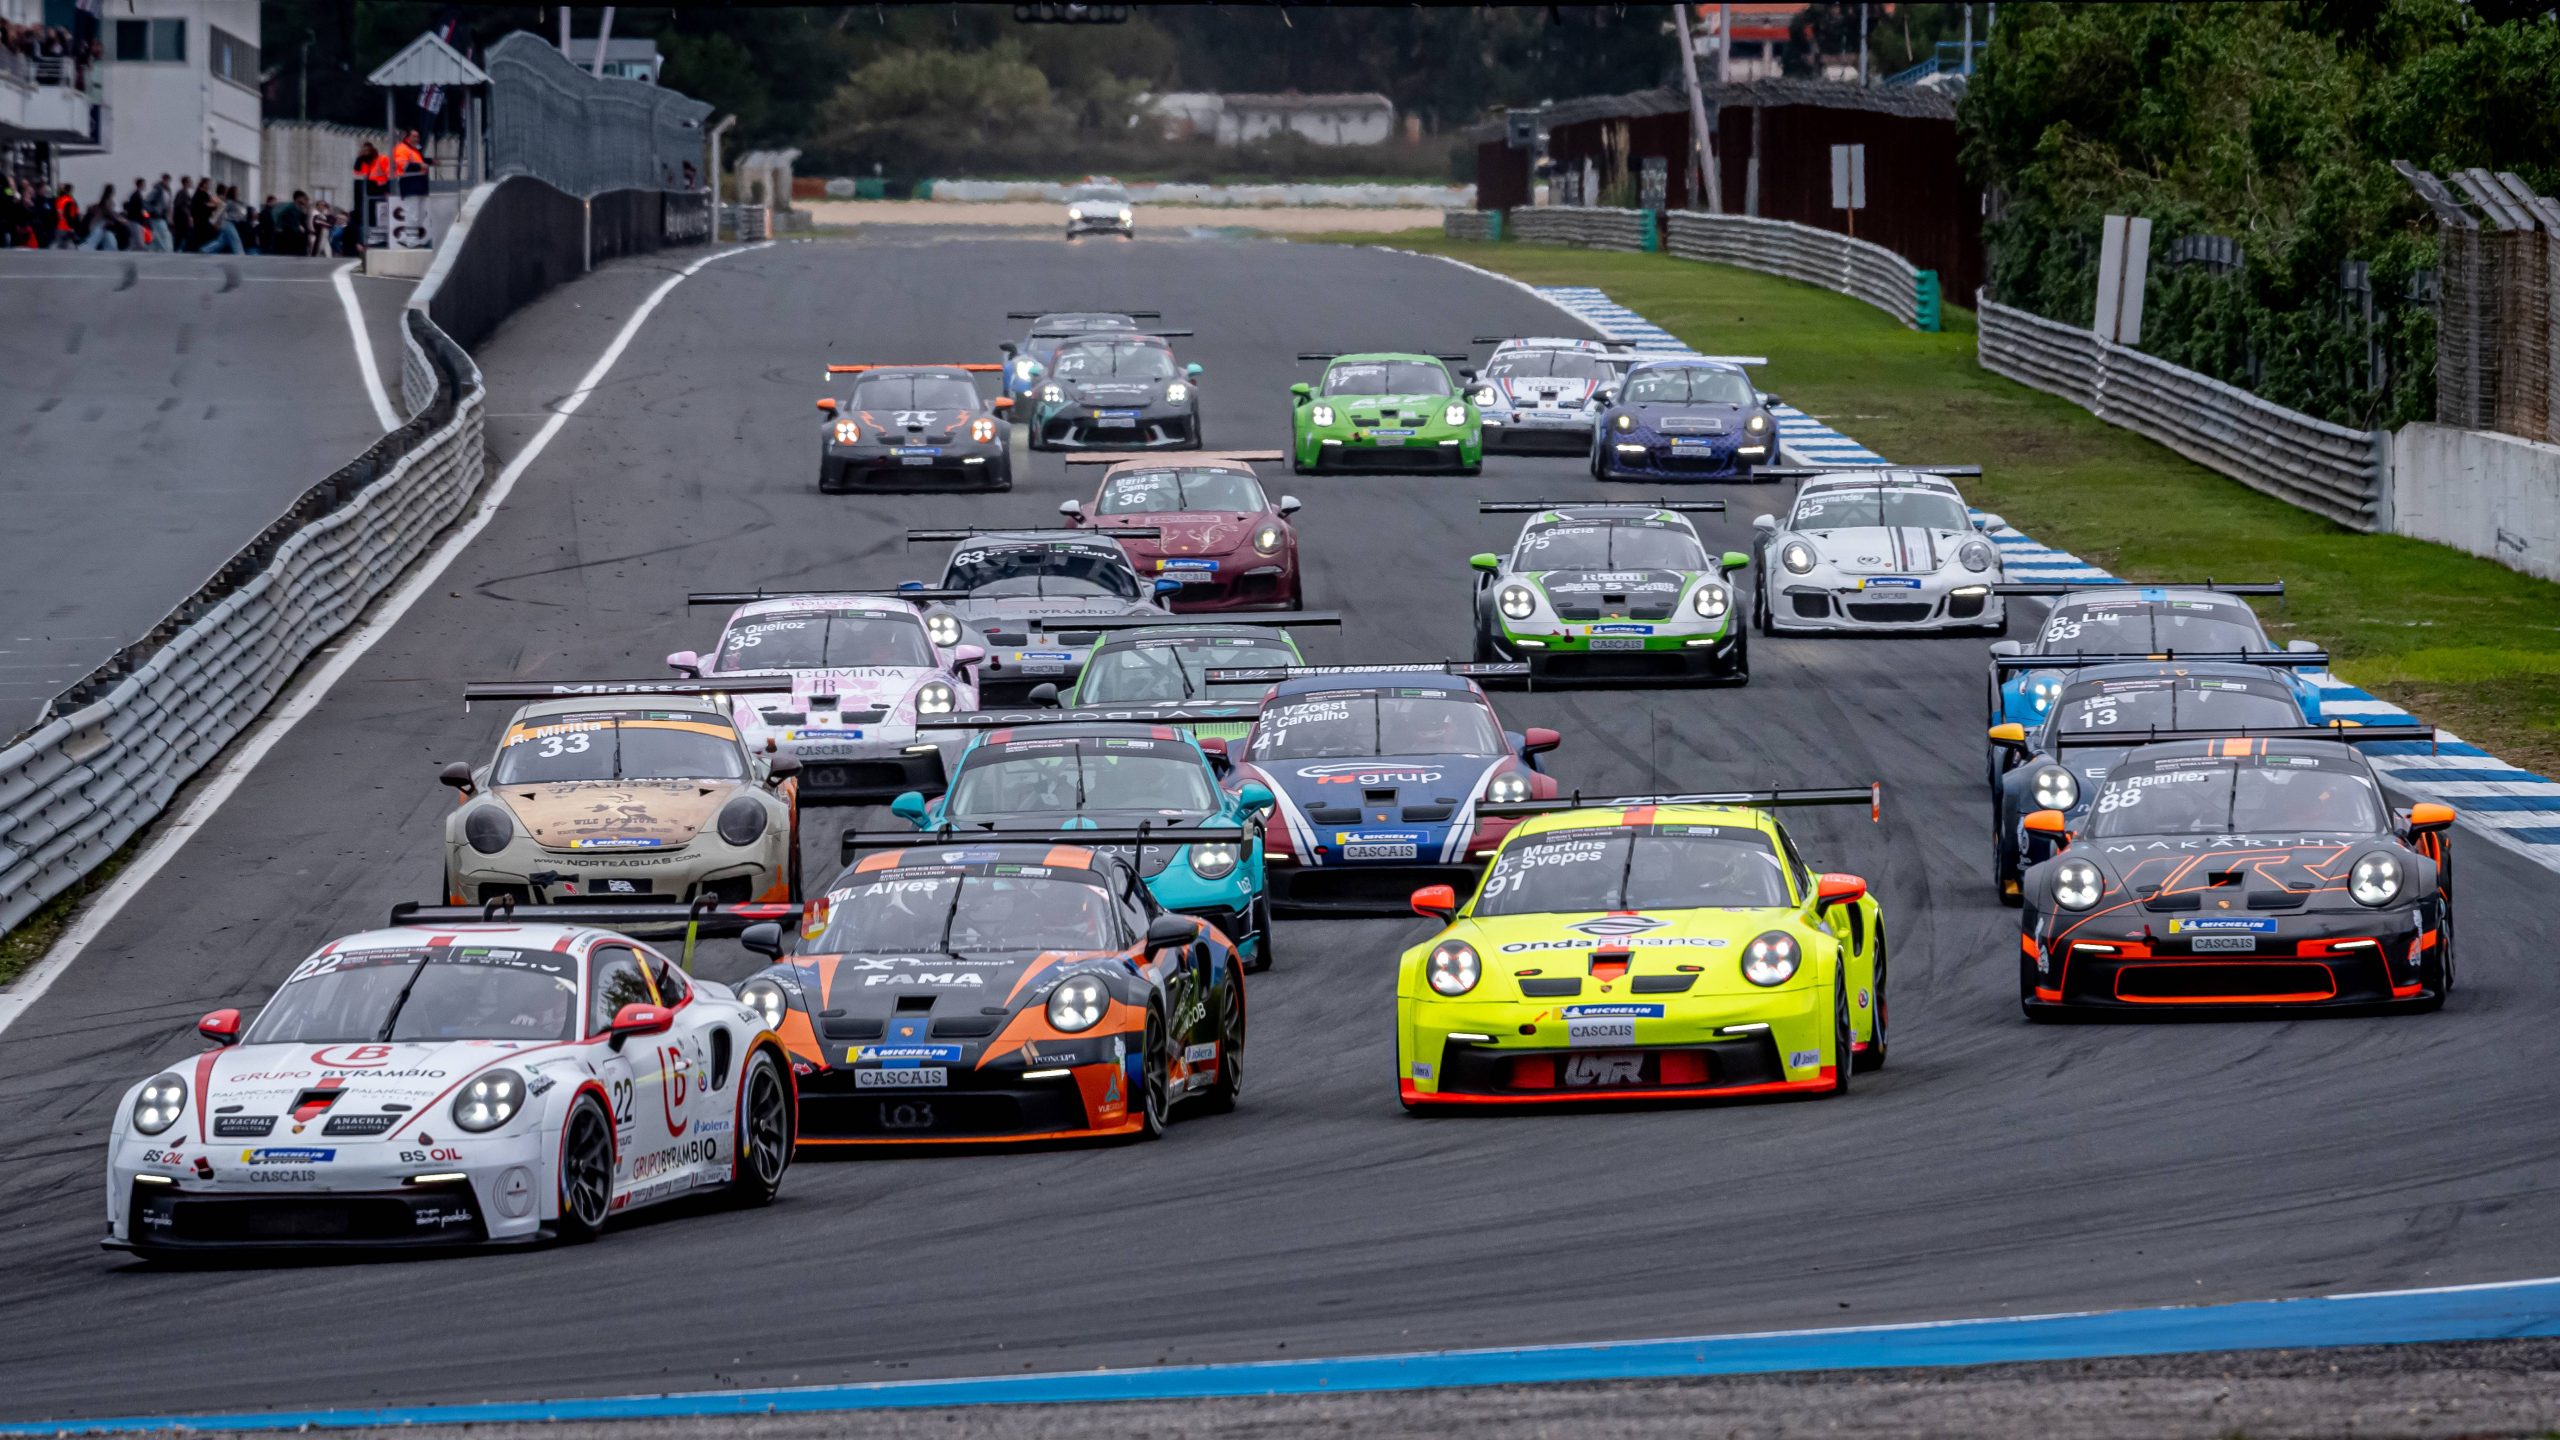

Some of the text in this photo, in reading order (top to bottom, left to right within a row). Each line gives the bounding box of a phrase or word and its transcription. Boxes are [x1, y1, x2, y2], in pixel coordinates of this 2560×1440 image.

[1493, 364, 1513, 375] 77
[1118, 493, 1147, 506] 36
[1797, 505, 1824, 520] 82
[1521, 537, 1550, 553] 75
[954, 551, 985, 567] 63
[2082, 612, 2118, 623] Liu
[745, 620, 806, 635] Queiroz
[2047, 624, 2081, 643] 93
[728, 633, 762, 650] 35
[1591, 640, 1642, 650] CASCAIS
[1276, 711, 1350, 727] Carvalho
[2080, 710, 2118, 728] 13
[536, 721, 601, 740] Miritta
[538, 733, 590, 758] 33
[1252, 730, 1287, 750] 41
[796, 745, 854, 757] CASCAIS
[2104, 772, 2208, 794] J. Ramirez
[2098, 788, 2142, 814] 88
[1347, 846, 1414, 857] CASCAIS
[1522, 841, 1607, 858] Martins
[2106, 839, 2357, 853] MAKARTHY
[1522, 851, 1602, 869] Svepes
[865, 882, 938, 898] Alves
[1483, 870, 1527, 899] 91
[1502, 936, 1729, 953] OndaFinance
[2195, 938, 2254, 950] CASCAIS
[290, 953, 344, 984] 22
[864, 973, 984, 987] FAMA
[1571, 1026, 1633, 1038] CASCAIS
[880, 1048, 948, 1056] MICHELIN
[230, 1070, 312, 1083] GRUPO
[860, 1071, 942, 1085] CASCAIS
[614, 1078, 633, 1125] 22
[333, 1117, 390, 1126] ANACHAL
[143, 1149, 183, 1165] BS OIL
[400, 1148, 463, 1162] BS OIL
[251, 1171, 316, 1182] CASCAIS
